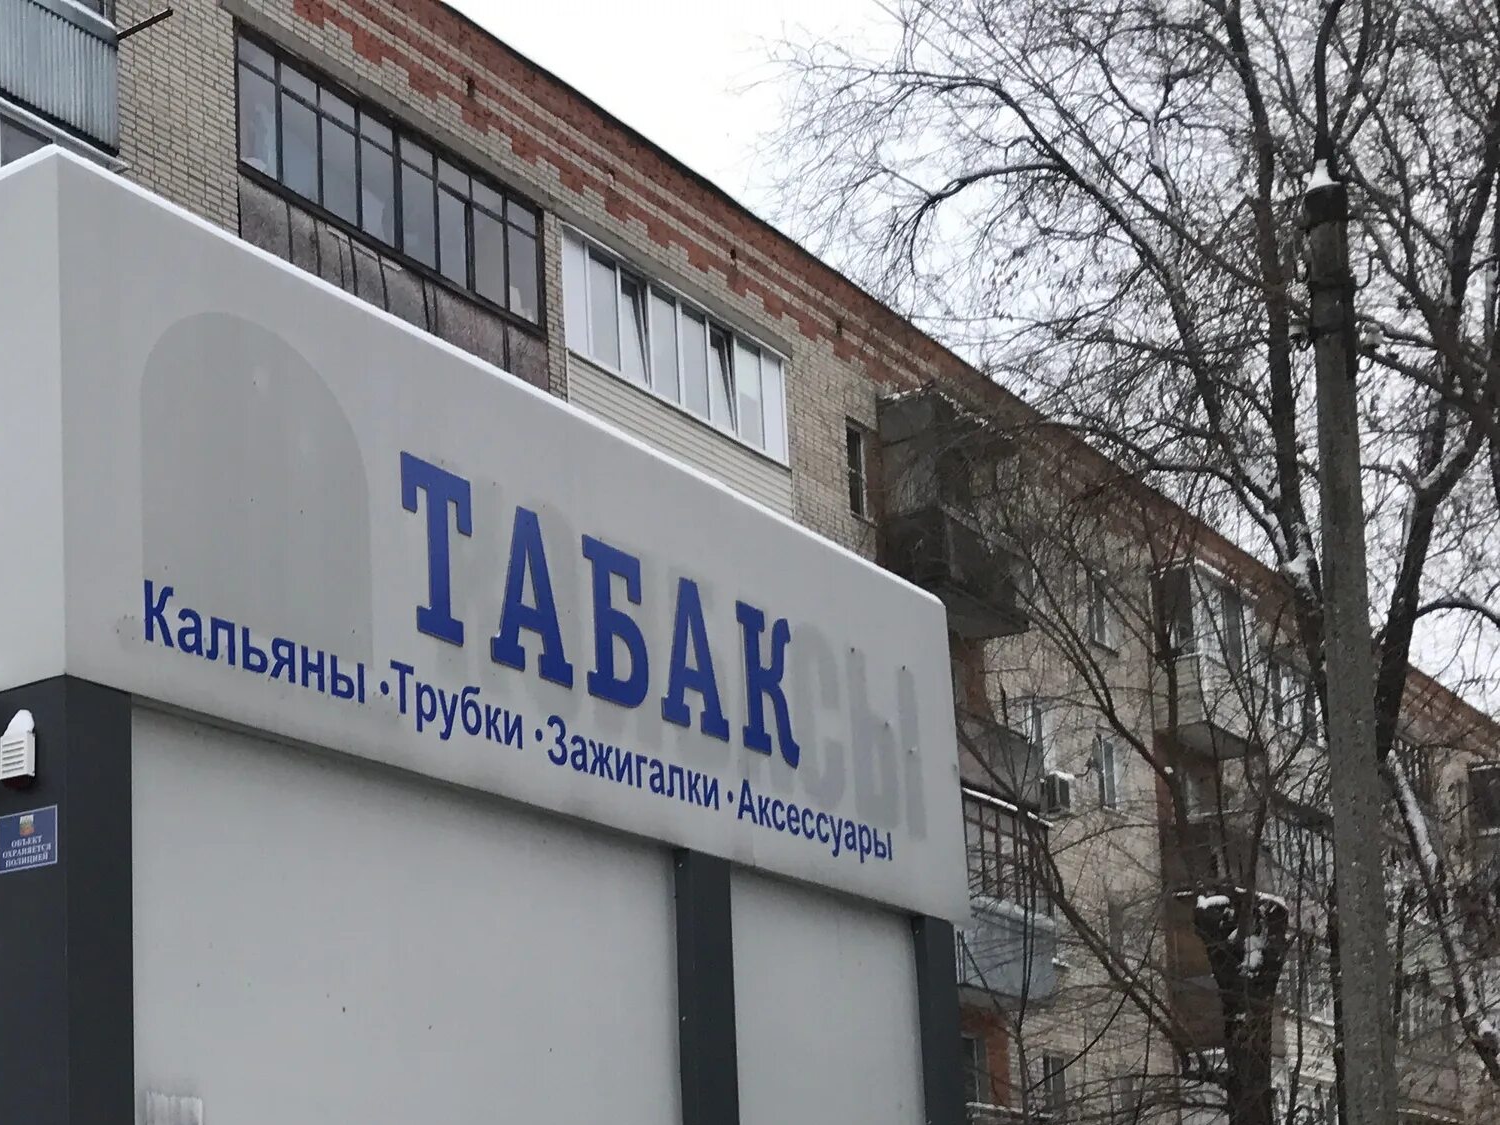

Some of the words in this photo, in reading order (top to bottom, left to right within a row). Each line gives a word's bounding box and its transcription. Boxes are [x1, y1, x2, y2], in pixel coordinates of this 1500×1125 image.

[401, 452, 801, 767] ТАБАК
[143, 580, 366, 704] Кальяны
[390, 660, 524, 748] Трубки
[546, 715, 720, 810] Зажигалки
[737, 782, 893, 862] Аксессуары
[11, 835, 43, 849] ОБЪЕКТ
[2, 843, 52, 860] ОХРАНЯЕТСЯ
[5, 852, 49, 868] ПОЛИЦИЕЙ
